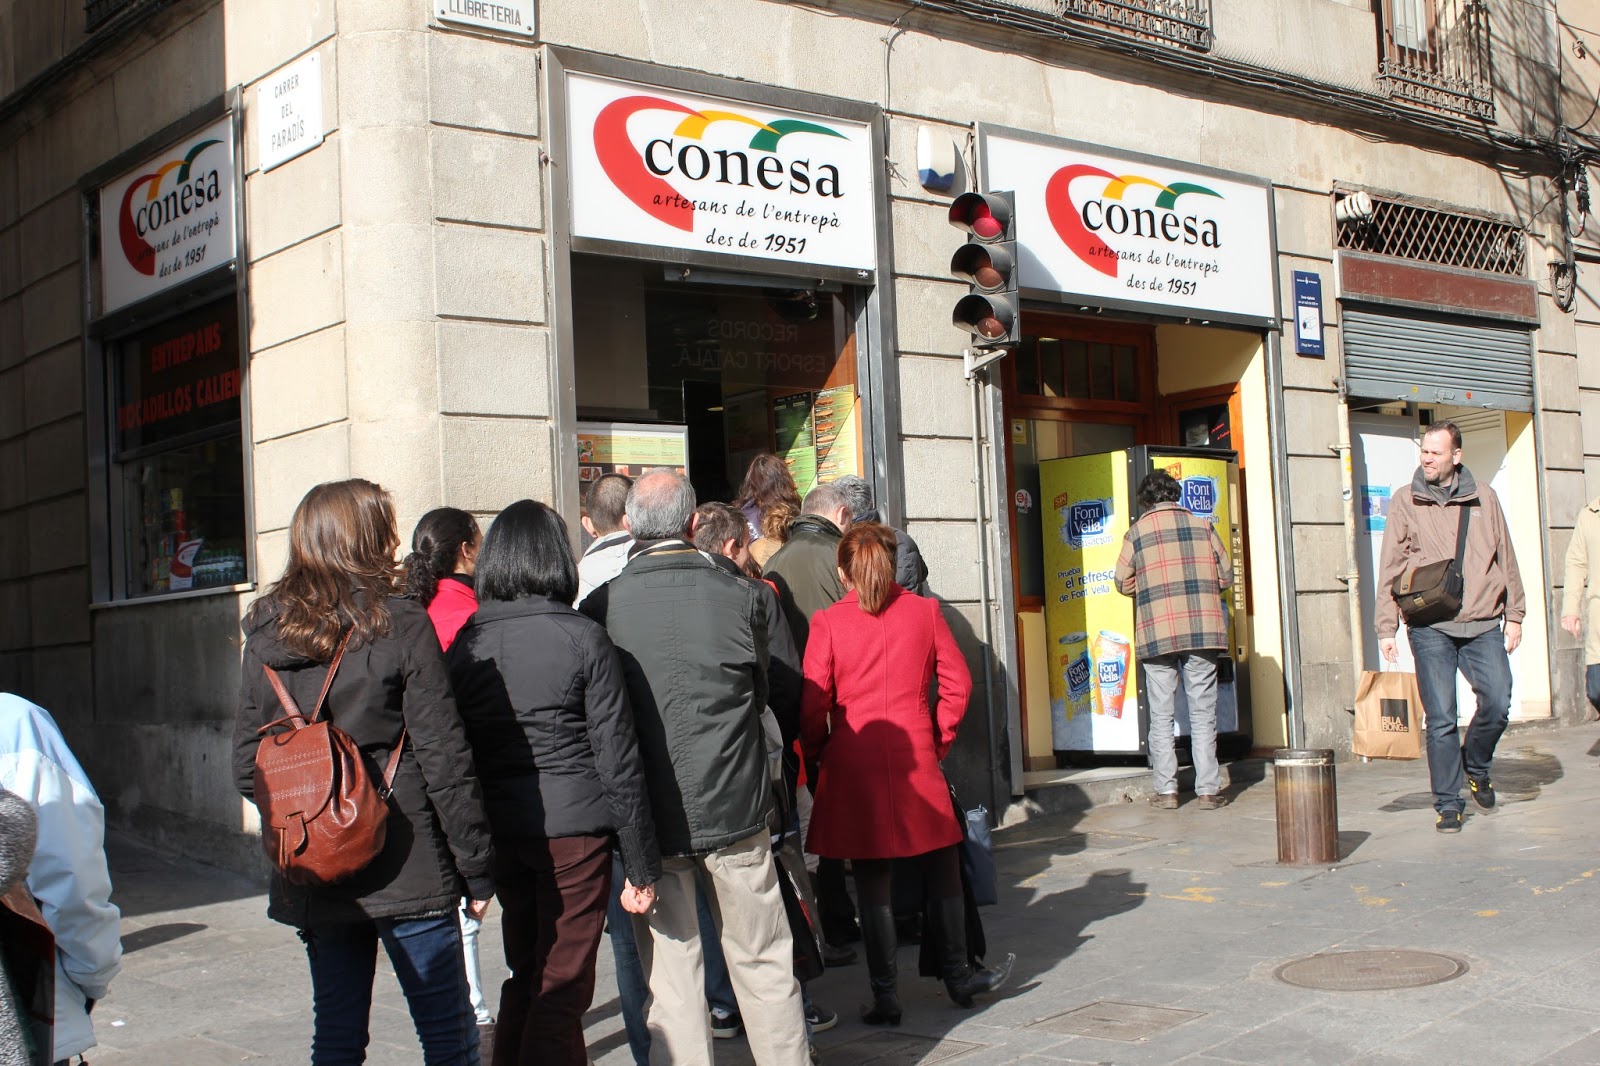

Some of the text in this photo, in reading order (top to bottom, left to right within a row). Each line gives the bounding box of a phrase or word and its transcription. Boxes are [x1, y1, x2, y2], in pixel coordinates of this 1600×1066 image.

[449, 0, 521, 26] LLIBRETERIA
[274, 74, 299, 99] CARRER
[281, 102, 293, 119] DEL
[271, 114, 304, 152] PARADÍS
[645, 137, 845, 198] conesa
[136, 169, 222, 238] conesa
[652, 193, 841, 234] artesans de l'entrepà
[1082, 199, 1222, 249] conesa
[172, 231, 182, 246] de
[705, 227, 733, 247] des
[738, 231, 760, 249] de
[1088, 245, 1142, 263] artesans
[1146, 250, 1162, 266] de
[1126, 273, 1146, 290] des
[1149, 276, 1165, 292] de
[1186, 481, 1210, 496] Font
[1186, 496, 1211, 511] Vella
[1074, 506, 1100, 520] Font
[1073, 520, 1102, 534] Vella
[1057, 567, 1081, 578] Prueba
[1065, 577, 1074, 589] el
[1059, 584, 1110, 603] de Font Vella
[1068, 662, 1086, 678] Font
[1099, 662, 1117, 673] Font
[1070, 670, 1090, 686] Vella
[1099, 672, 1119, 683] Vella
